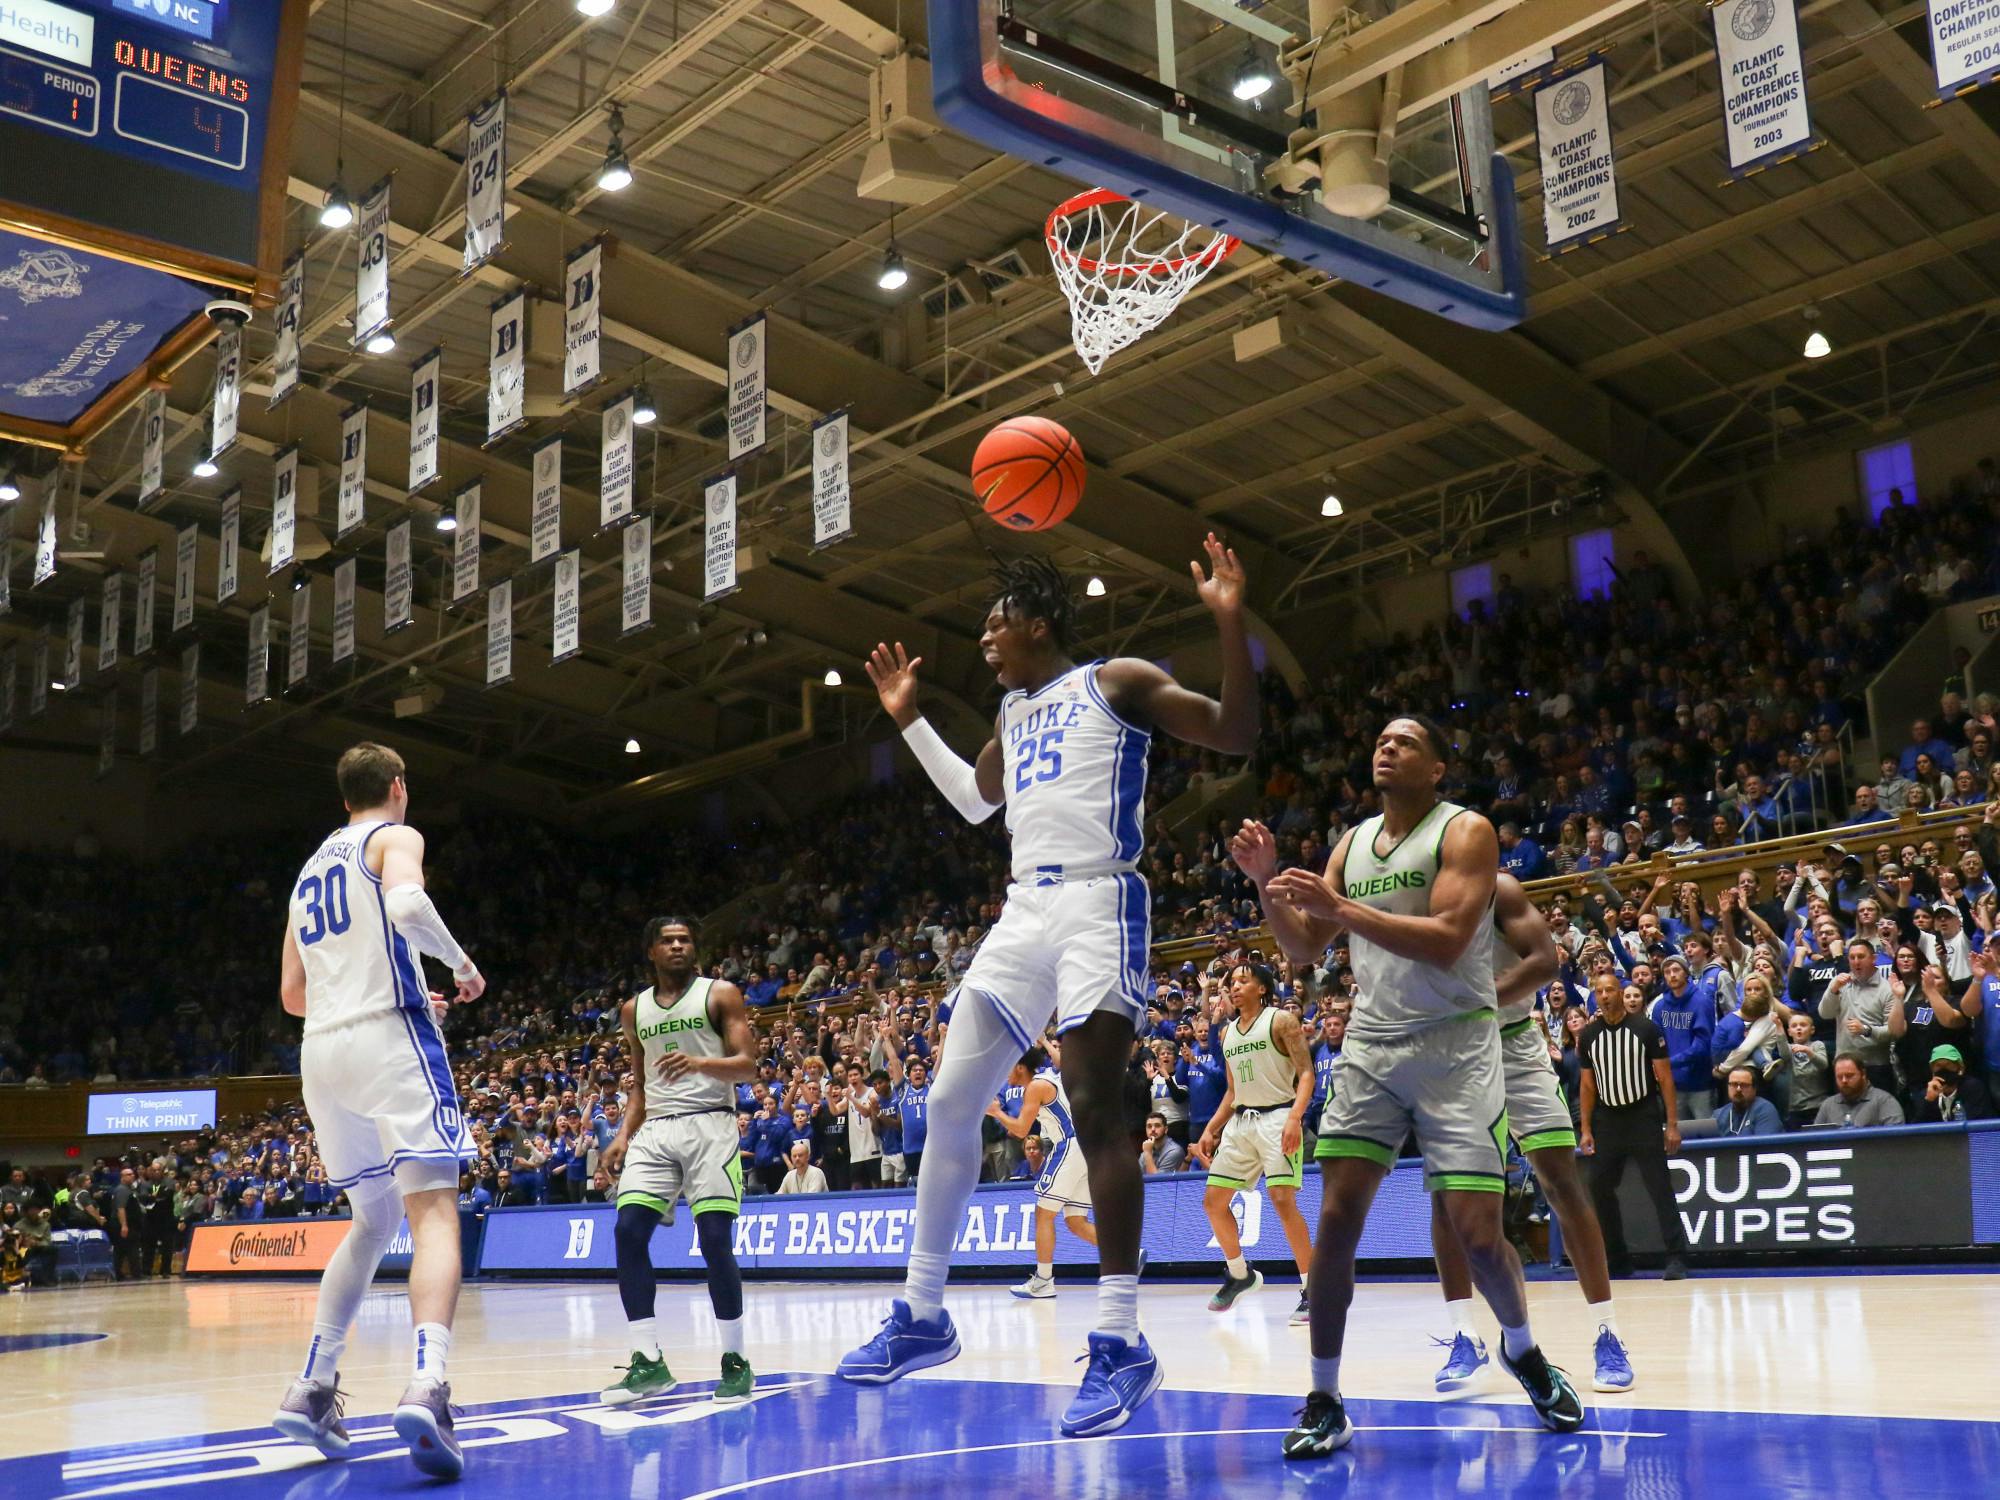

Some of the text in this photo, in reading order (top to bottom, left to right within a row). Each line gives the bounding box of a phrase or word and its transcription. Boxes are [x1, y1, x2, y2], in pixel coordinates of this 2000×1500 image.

[174, 2, 200, 24] NC
[0, 6, 79, 49] Health
[1947, 33, 1982, 53] REGULAR
[1732, 44, 1785, 76] ATLANTIC
[1964, 42, 2000, 69] 2004
[114, 39, 249, 103] QUEENS
[1742, 63, 1778, 87] COAST
[44, 72, 95, 98] PERIOD
[1727, 71, 1800, 111] CONFERENCE
[72, 97, 79, 120] 1
[1732, 88, 1799, 125] CHAMPIONS
[193, 105, 223, 153] 4
[1743, 109, 1789, 133] TOURNAMENT
[1551, 128, 1597, 157] ATLANTIC
[1754, 128, 1783, 149] 2003
[1559, 146, 1592, 169] COAST
[472, 150, 499, 197] 24
[1545, 154, 1611, 190] CONFERENCE
[1550, 170, 1610, 203] CHAMPIONS
[1560, 192, 1601, 213] TOURNAMENT
[1566, 208, 1596, 229] 2002
[361, 232, 384, 271] 43
[733, 370, 759, 392] ATLANTIC
[737, 384, 755, 401] COAST
[729, 391, 764, 417] CONFERENCE
[730, 403, 762, 428] CHAMPIONS
[606, 443, 627, 461] ATLANTIC
[609, 456, 625, 471] COAST
[601, 463, 632, 486] CONFERENCE
[602, 475, 630, 496] CHAMPIONS
[709, 520, 731, 536] ATLANTIC
[712, 532, 728, 545] COAST
[825, 520, 839, 534] 2001
[706, 539, 735, 559] CONFERENCE
[707, 550, 733, 568] CHAMPIONS
[1010, 701, 1088, 746] DUKE
[1015, 729, 1065, 793] 25
[1348, 871, 1426, 899] QUEENS
[298, 863, 351, 946] 30
[1809, 967, 1837, 981] DUK
[639, 1018, 704, 1040] QUEENS
[1225, 1040, 1267, 1058] QUEENS
[1237, 1058, 1255, 1083] 11
[106, 1113, 198, 1129] THINK PRINT
[784, 1203, 1035, 1254] BASKEALL
[229, 1229, 298, 1266] Continental
